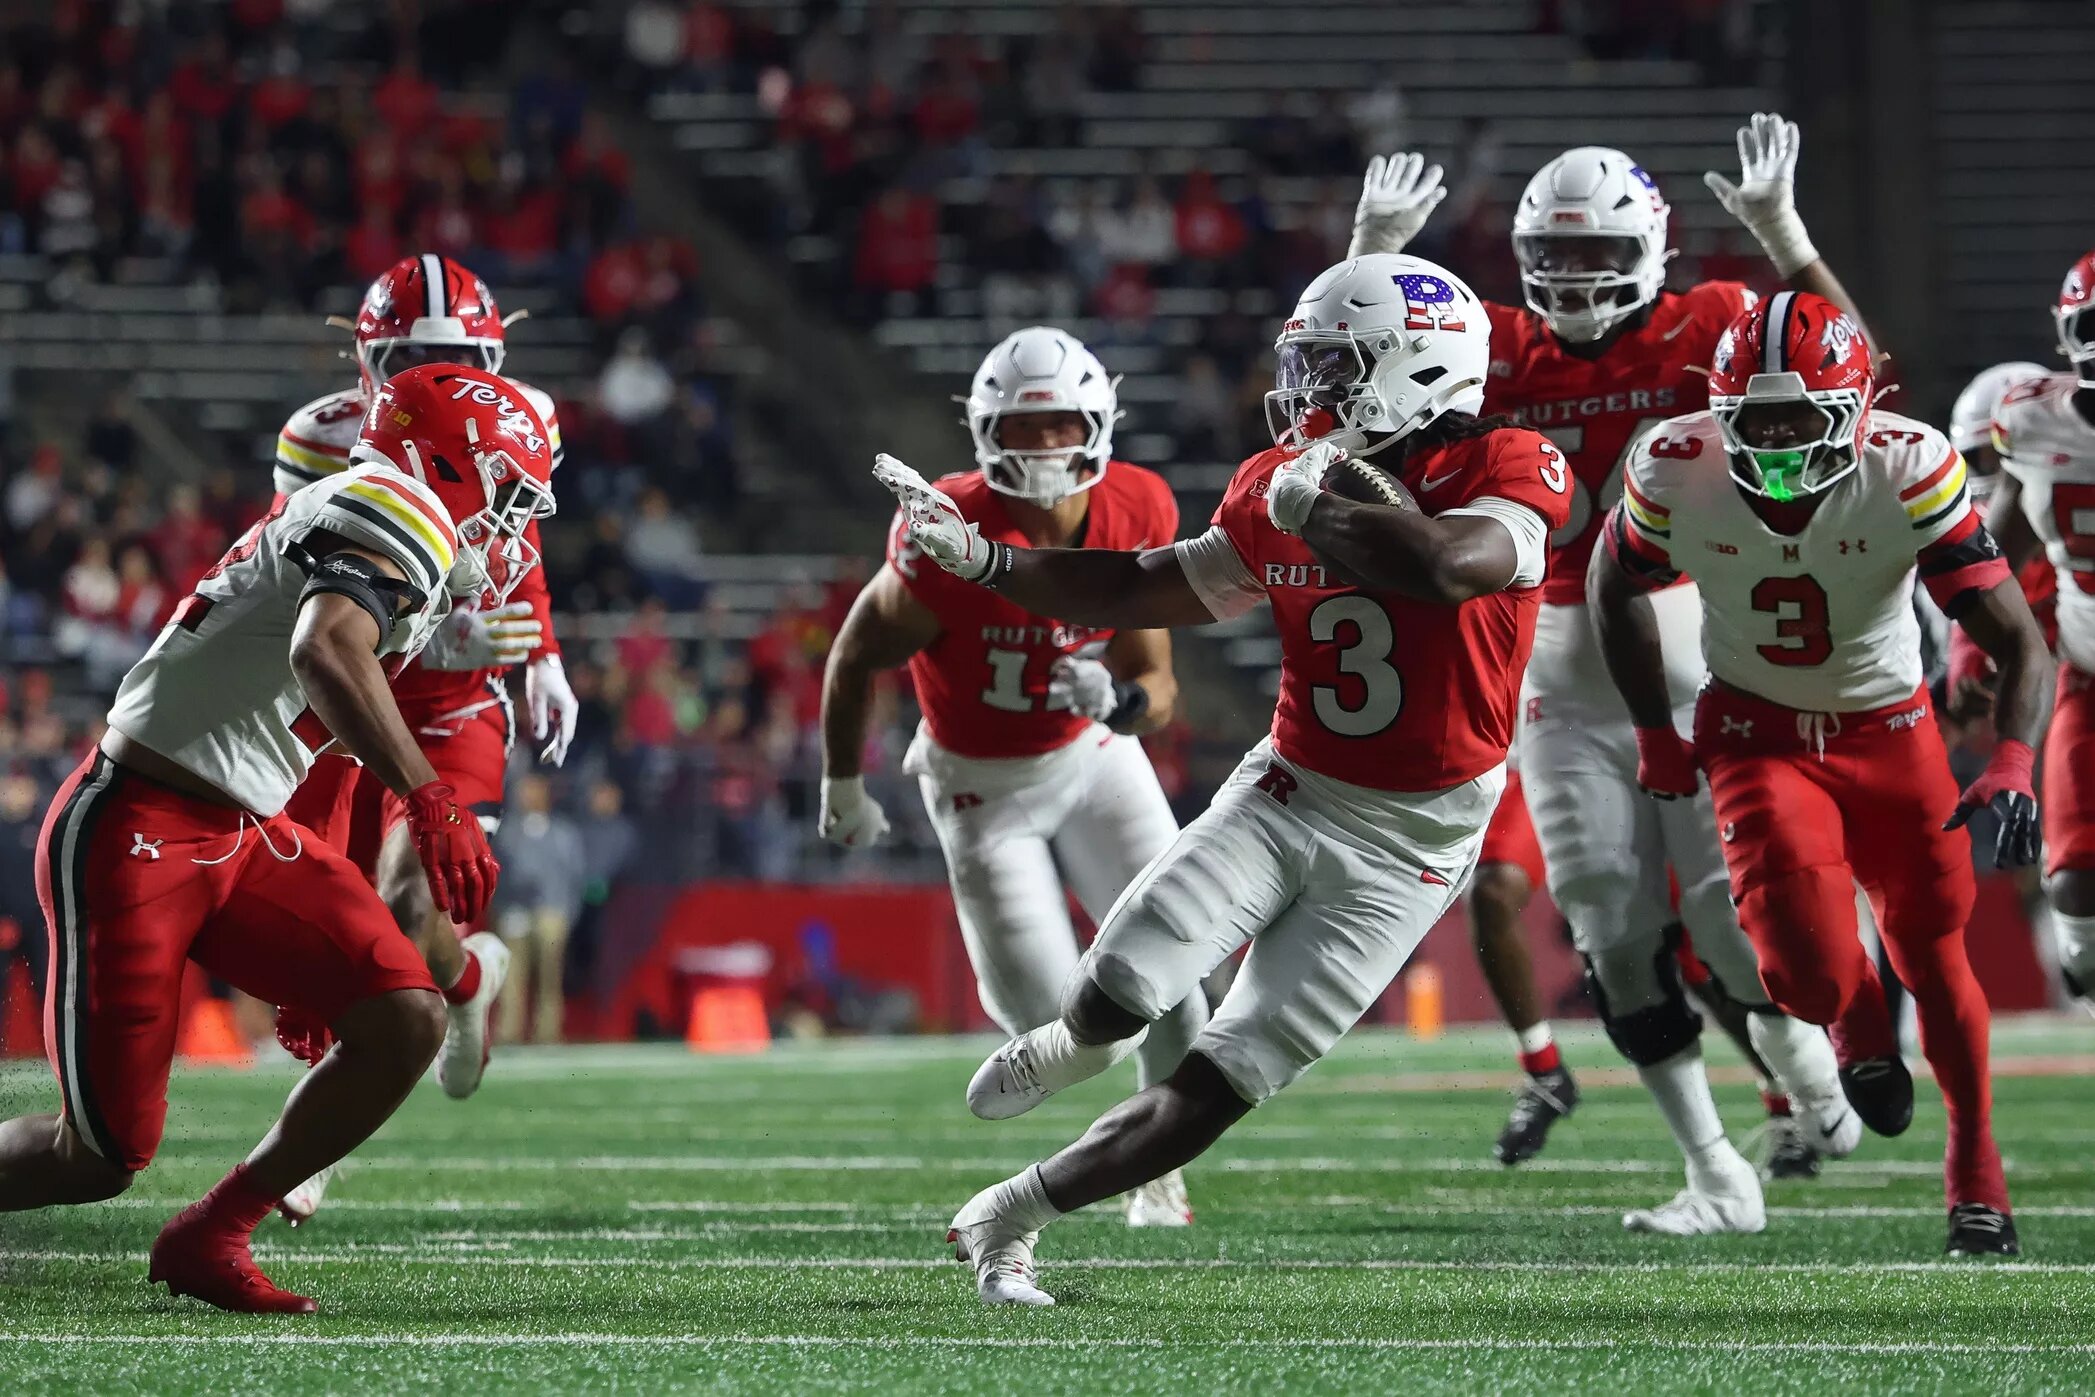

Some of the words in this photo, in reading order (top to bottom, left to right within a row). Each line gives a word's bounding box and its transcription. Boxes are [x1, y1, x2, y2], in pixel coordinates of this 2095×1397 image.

[1392, 274, 1466, 333] R
[451, 377, 545, 452] Terps
[1538, 442, 1567, 495] 3
[1782, 544, 1800, 563] M
[1751, 573, 1834, 667] 3
[1310, 596, 1402, 737] 3
[1252, 760, 1299, 807] R
